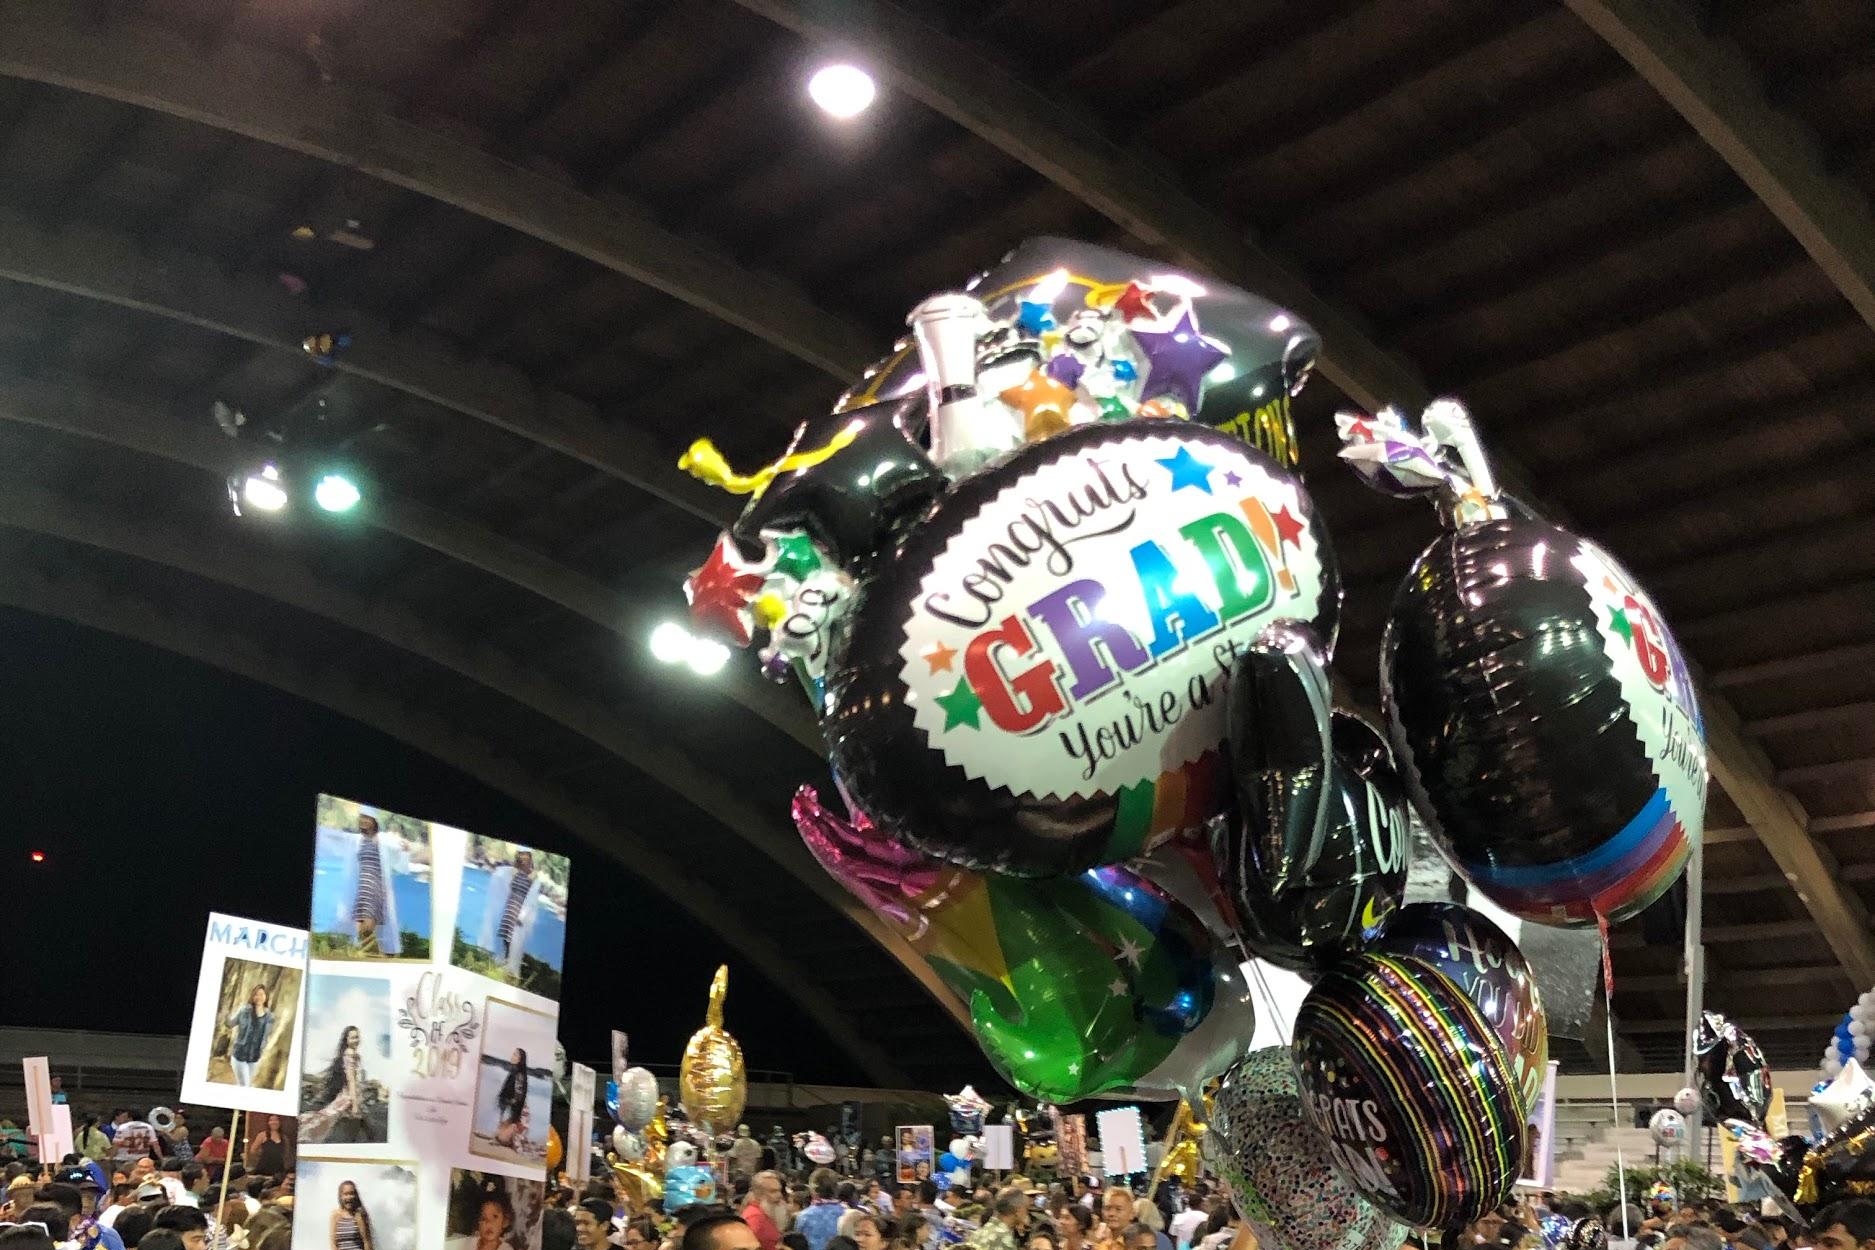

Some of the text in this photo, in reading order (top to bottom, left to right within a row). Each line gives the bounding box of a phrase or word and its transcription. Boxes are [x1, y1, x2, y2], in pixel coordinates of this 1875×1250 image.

[925, 458, 1148, 631] Congrats
[964, 495, 1301, 738] GRAD!
[1059, 688, 1183, 781] You're
[1187, 674, 1212, 715] a
[209, 920, 309, 959] MARCH
